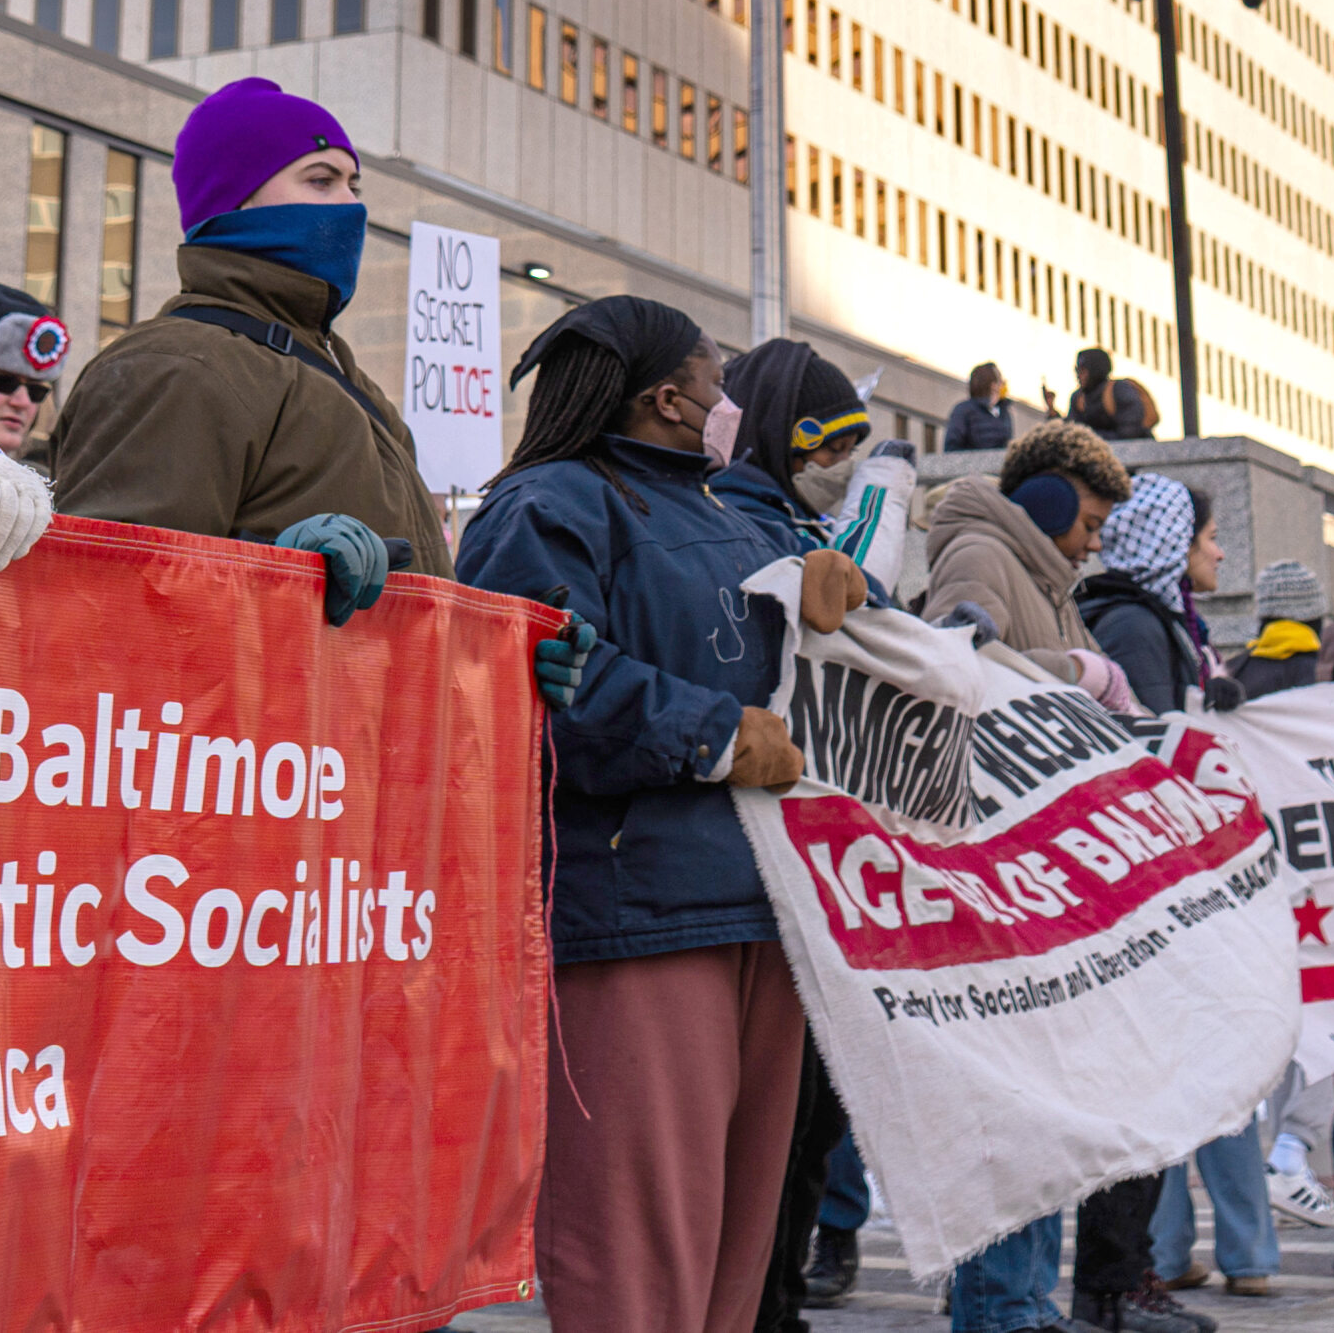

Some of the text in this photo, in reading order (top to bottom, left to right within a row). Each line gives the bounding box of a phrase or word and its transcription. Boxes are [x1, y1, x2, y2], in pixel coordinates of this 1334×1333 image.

[437, 235, 473, 292] NO
[413, 288, 485, 352] SECRET
[411, 354, 494, 418] POLICE
[115, 853, 437, 968] Socialists
[807, 834, 955, 930] ICE
[994, 849, 1085, 919] OF
